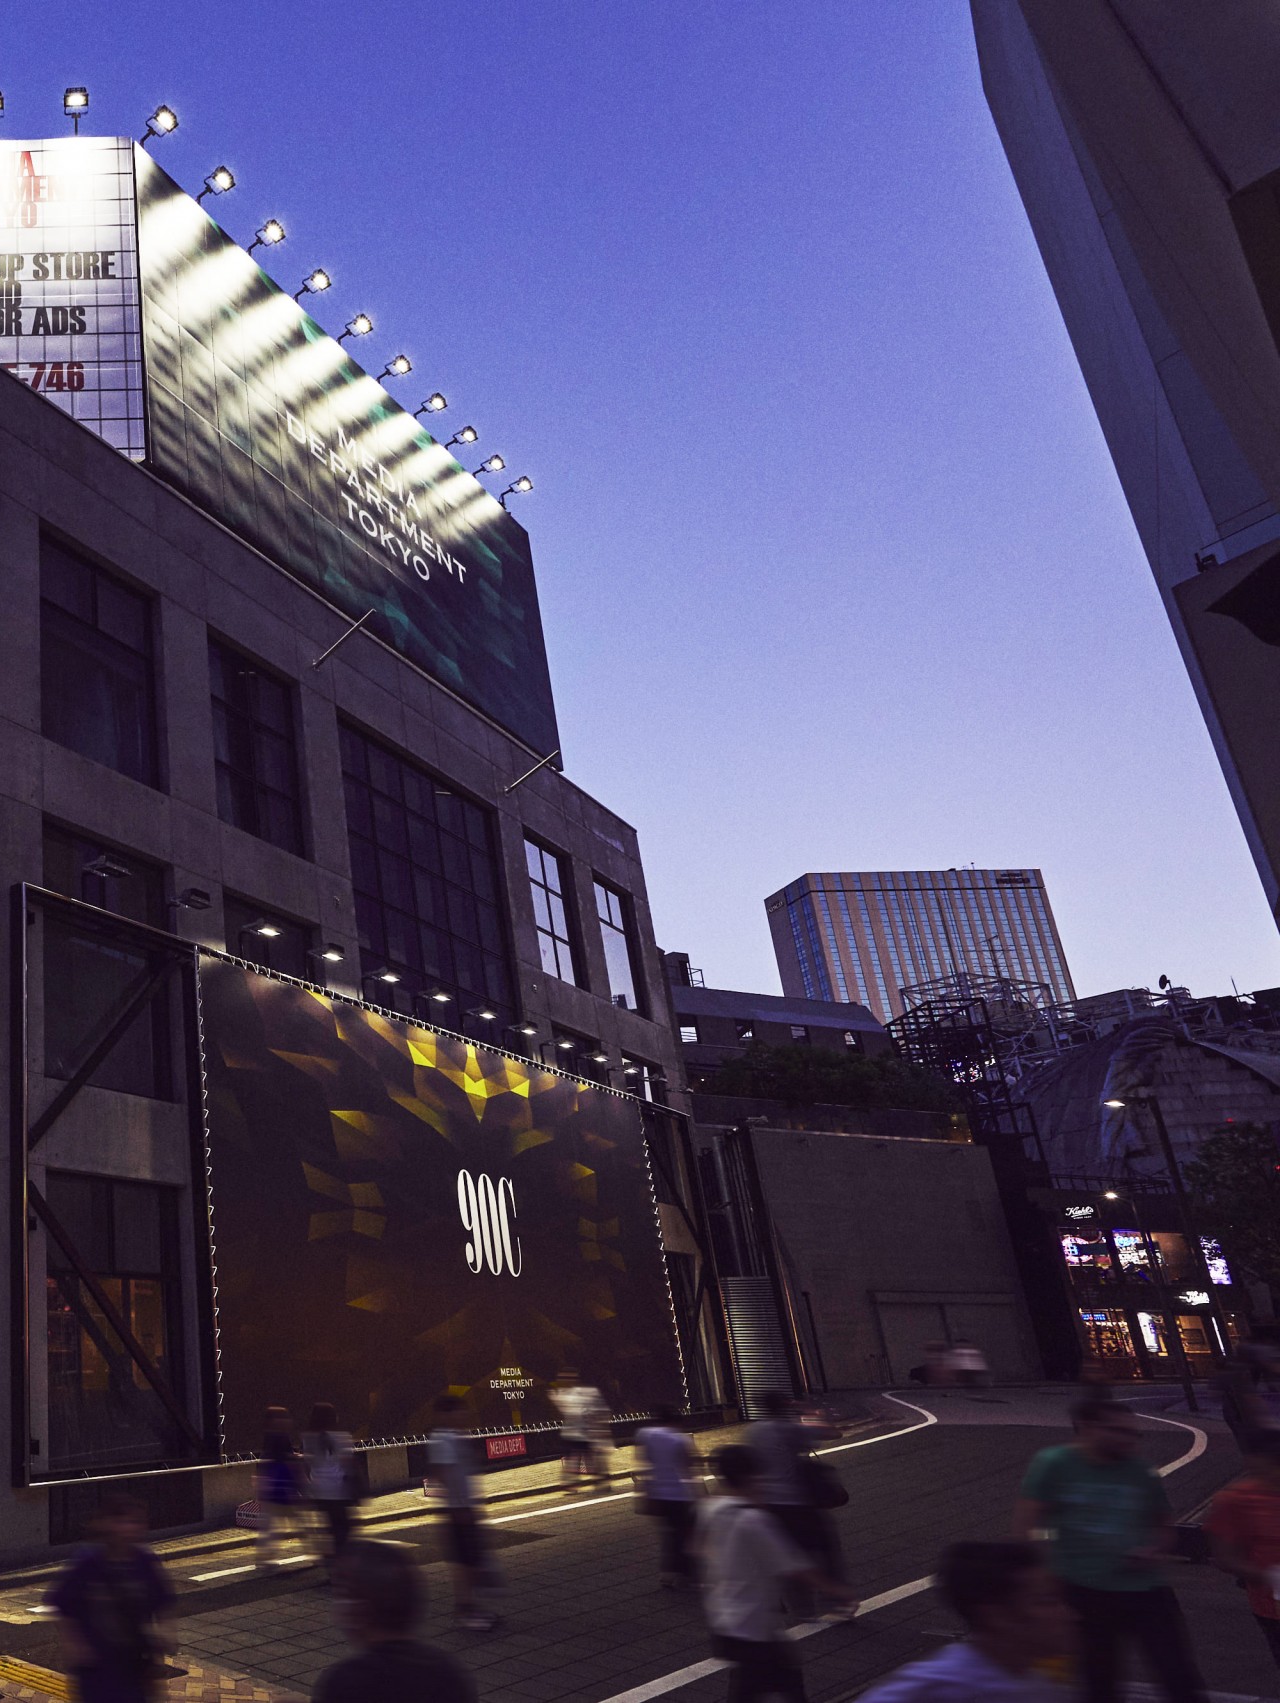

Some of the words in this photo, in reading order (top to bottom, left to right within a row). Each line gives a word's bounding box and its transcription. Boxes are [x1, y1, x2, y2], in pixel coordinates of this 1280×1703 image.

[32, 251, 116, 281] STORE
[31, 306, 87, 335] ADS
[336, 425, 422, 520] MEDIA
[285, 409, 467, 584] DEPARTMENT
[340, 490, 430, 581] TOKYO
[457, 1169, 521, 1277] 90C
[490, 1379, 533, 1388] DEPARTMENT
[500, 1368, 521, 1376] MEDIA
[503, 1391, 525, 1399] TOKYO
[489, 1439, 509, 1455] MEDIA
[508, 1438, 526, 1453] DEPT.
